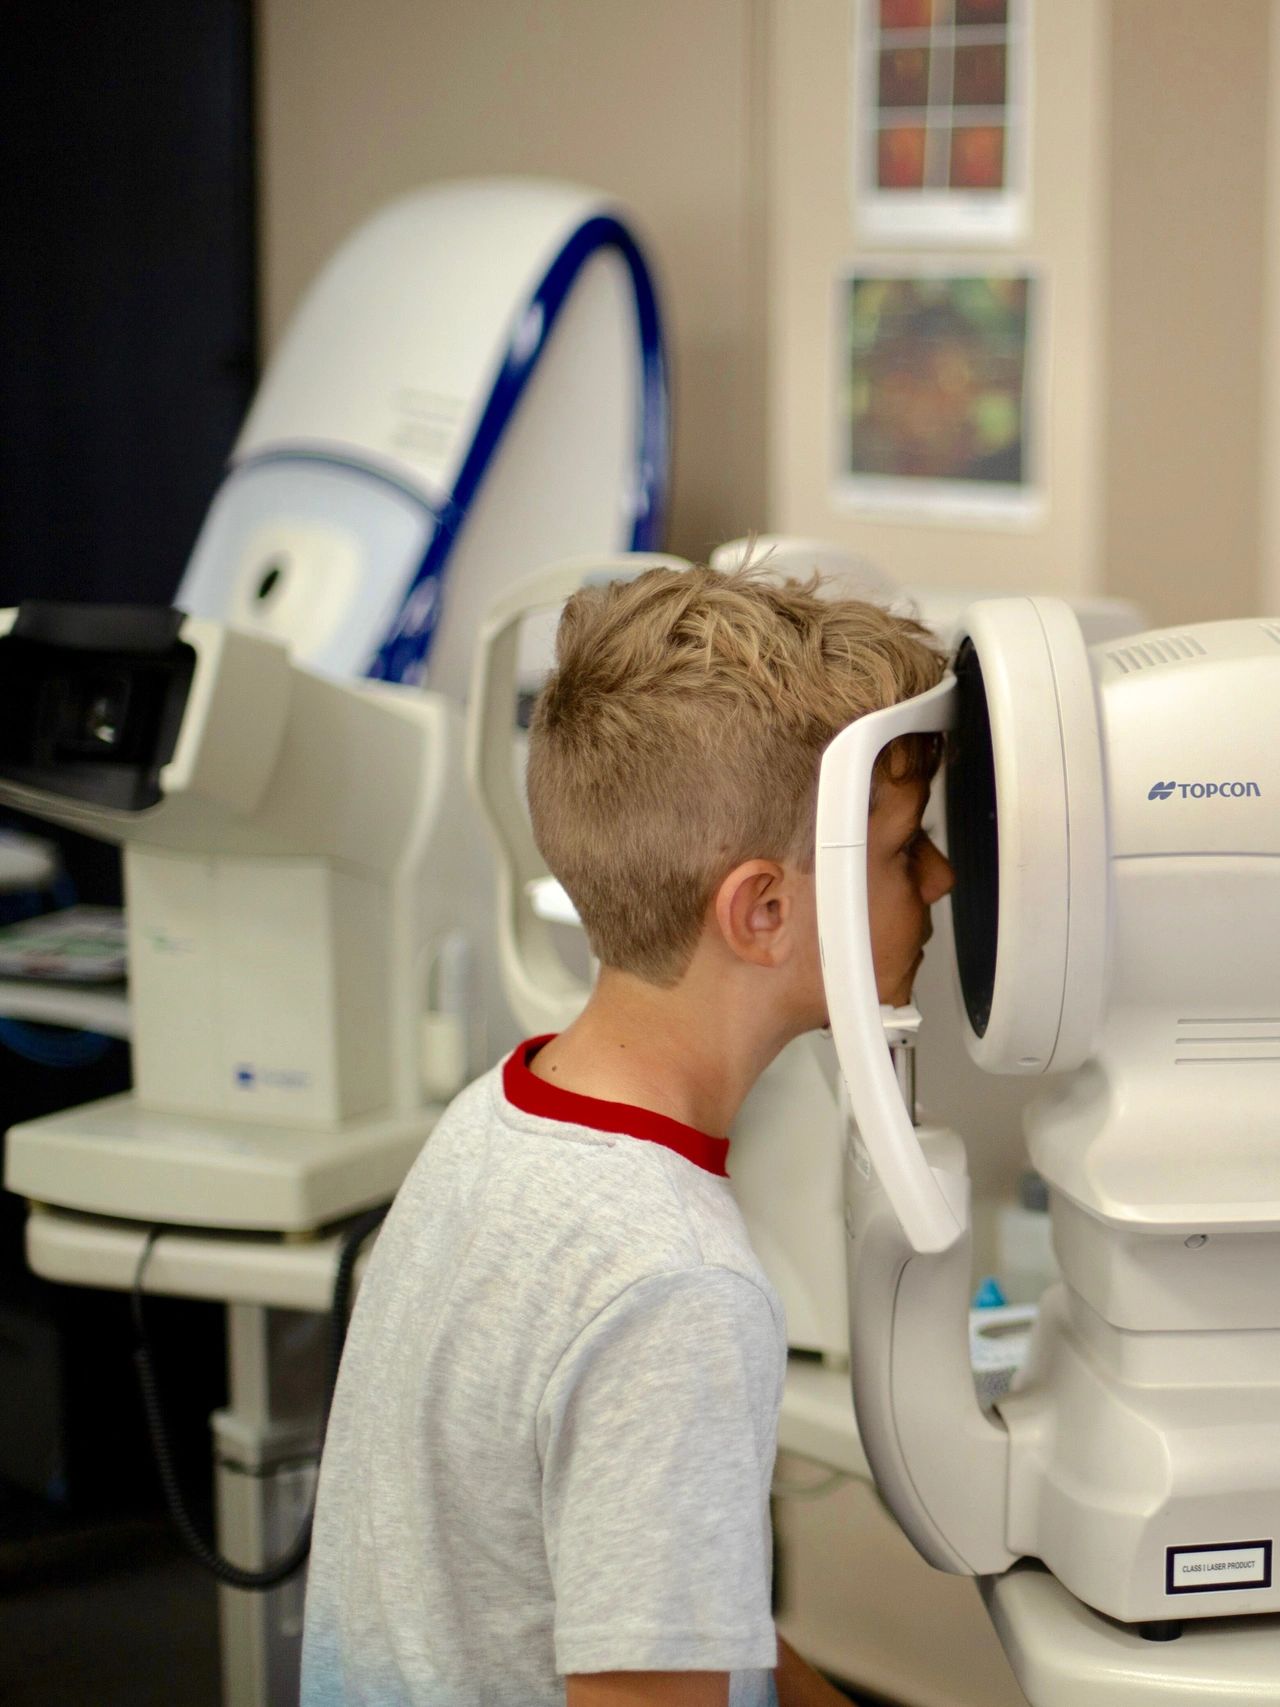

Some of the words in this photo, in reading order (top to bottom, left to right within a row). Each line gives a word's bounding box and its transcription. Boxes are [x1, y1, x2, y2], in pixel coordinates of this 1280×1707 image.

[1177, 782, 1261, 798] TOPCON
[1183, 1565, 1202, 1573] CLASS
[1207, 1562, 1226, 1571] LASER
[1227, 1561, 1255, 1569] PRODUCT
